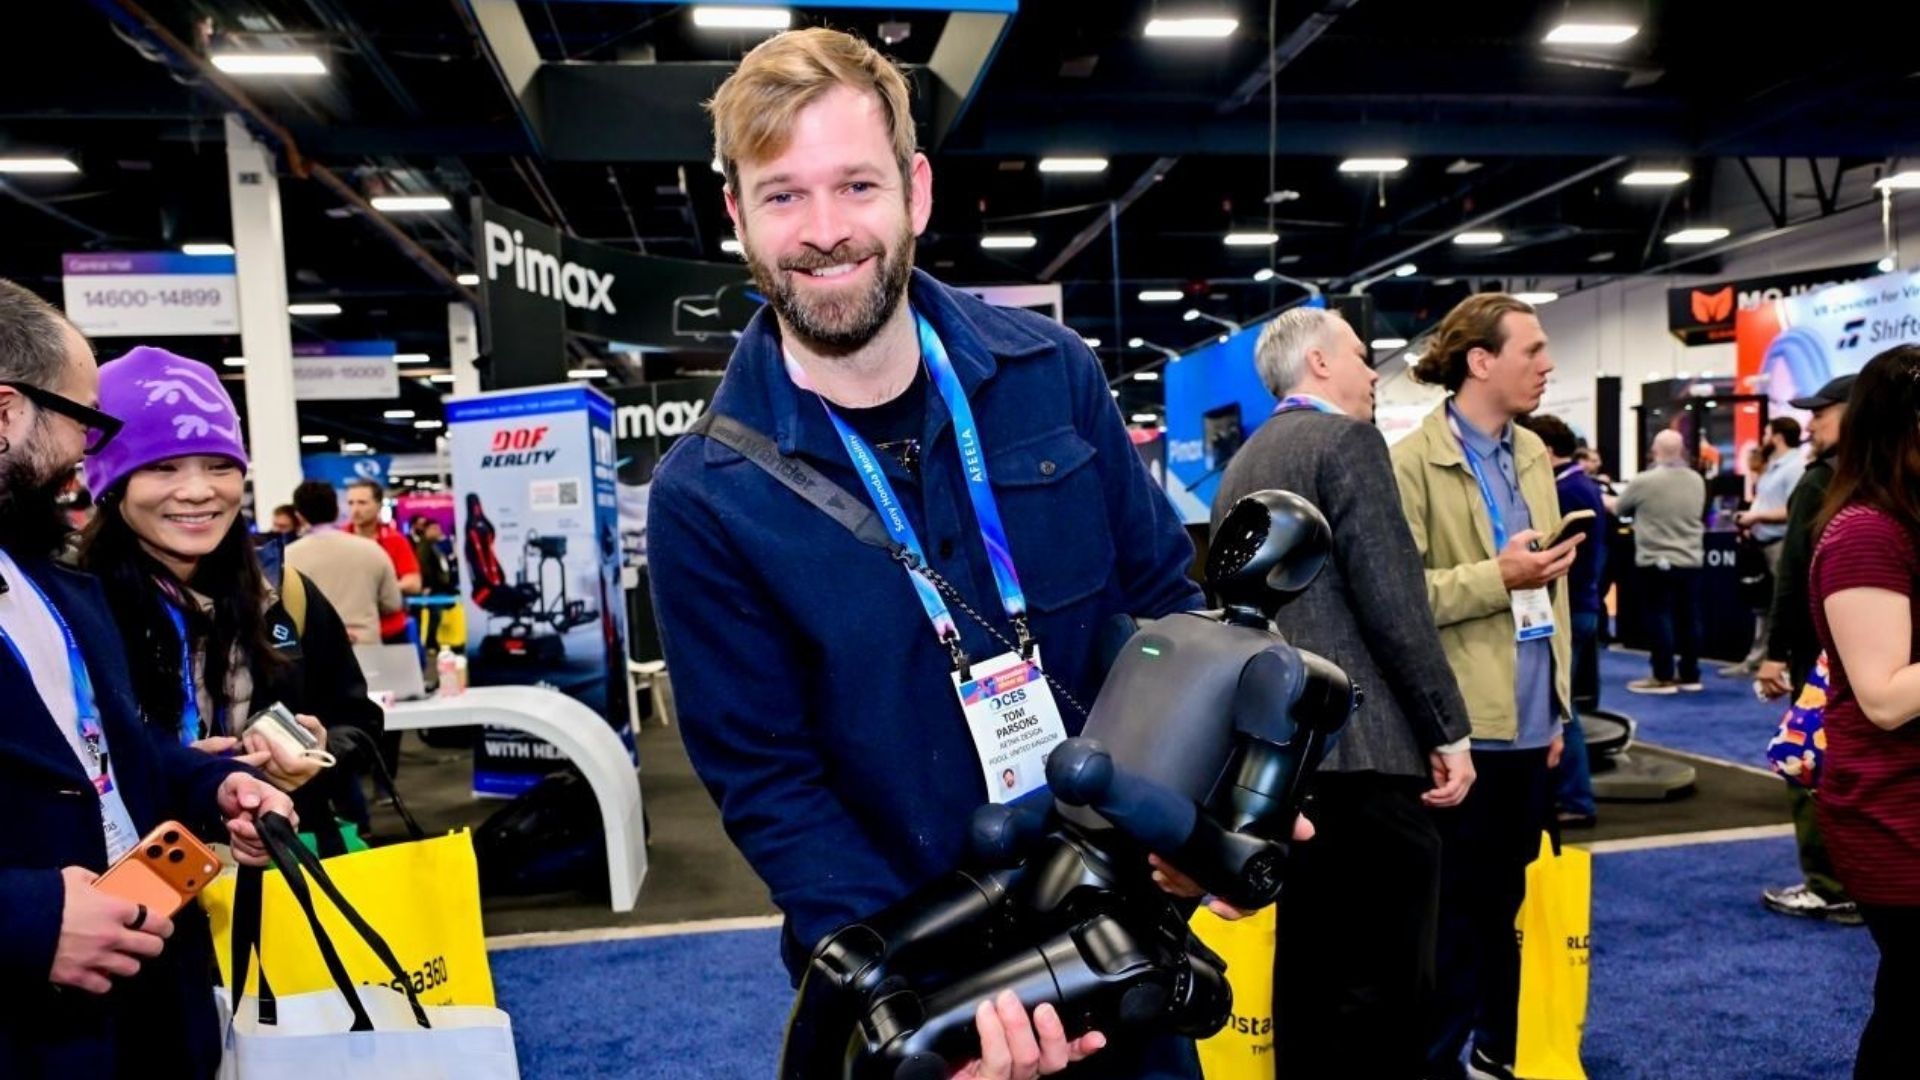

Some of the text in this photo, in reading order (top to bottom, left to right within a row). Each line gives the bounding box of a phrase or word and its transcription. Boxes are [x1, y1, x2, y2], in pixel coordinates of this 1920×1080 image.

[69, 258, 108, 271] Central
[483, 220, 617, 315] Pimax
[83, 288, 221, 307] 14600-14899
[491, 427, 549, 452] DOF
[481, 450, 557, 469] REALITY
[961, 428, 984, 483] AFEELA
[848, 434, 905, 533] Sony Honda Mobility
[1704, 549, 1736, 567] ON
[1002, 689, 1027, 706] CES
[1002, 706, 1026, 723] TOM
[996, 715, 1039, 739] PARSONS
[485, 740, 530, 759] WITH
